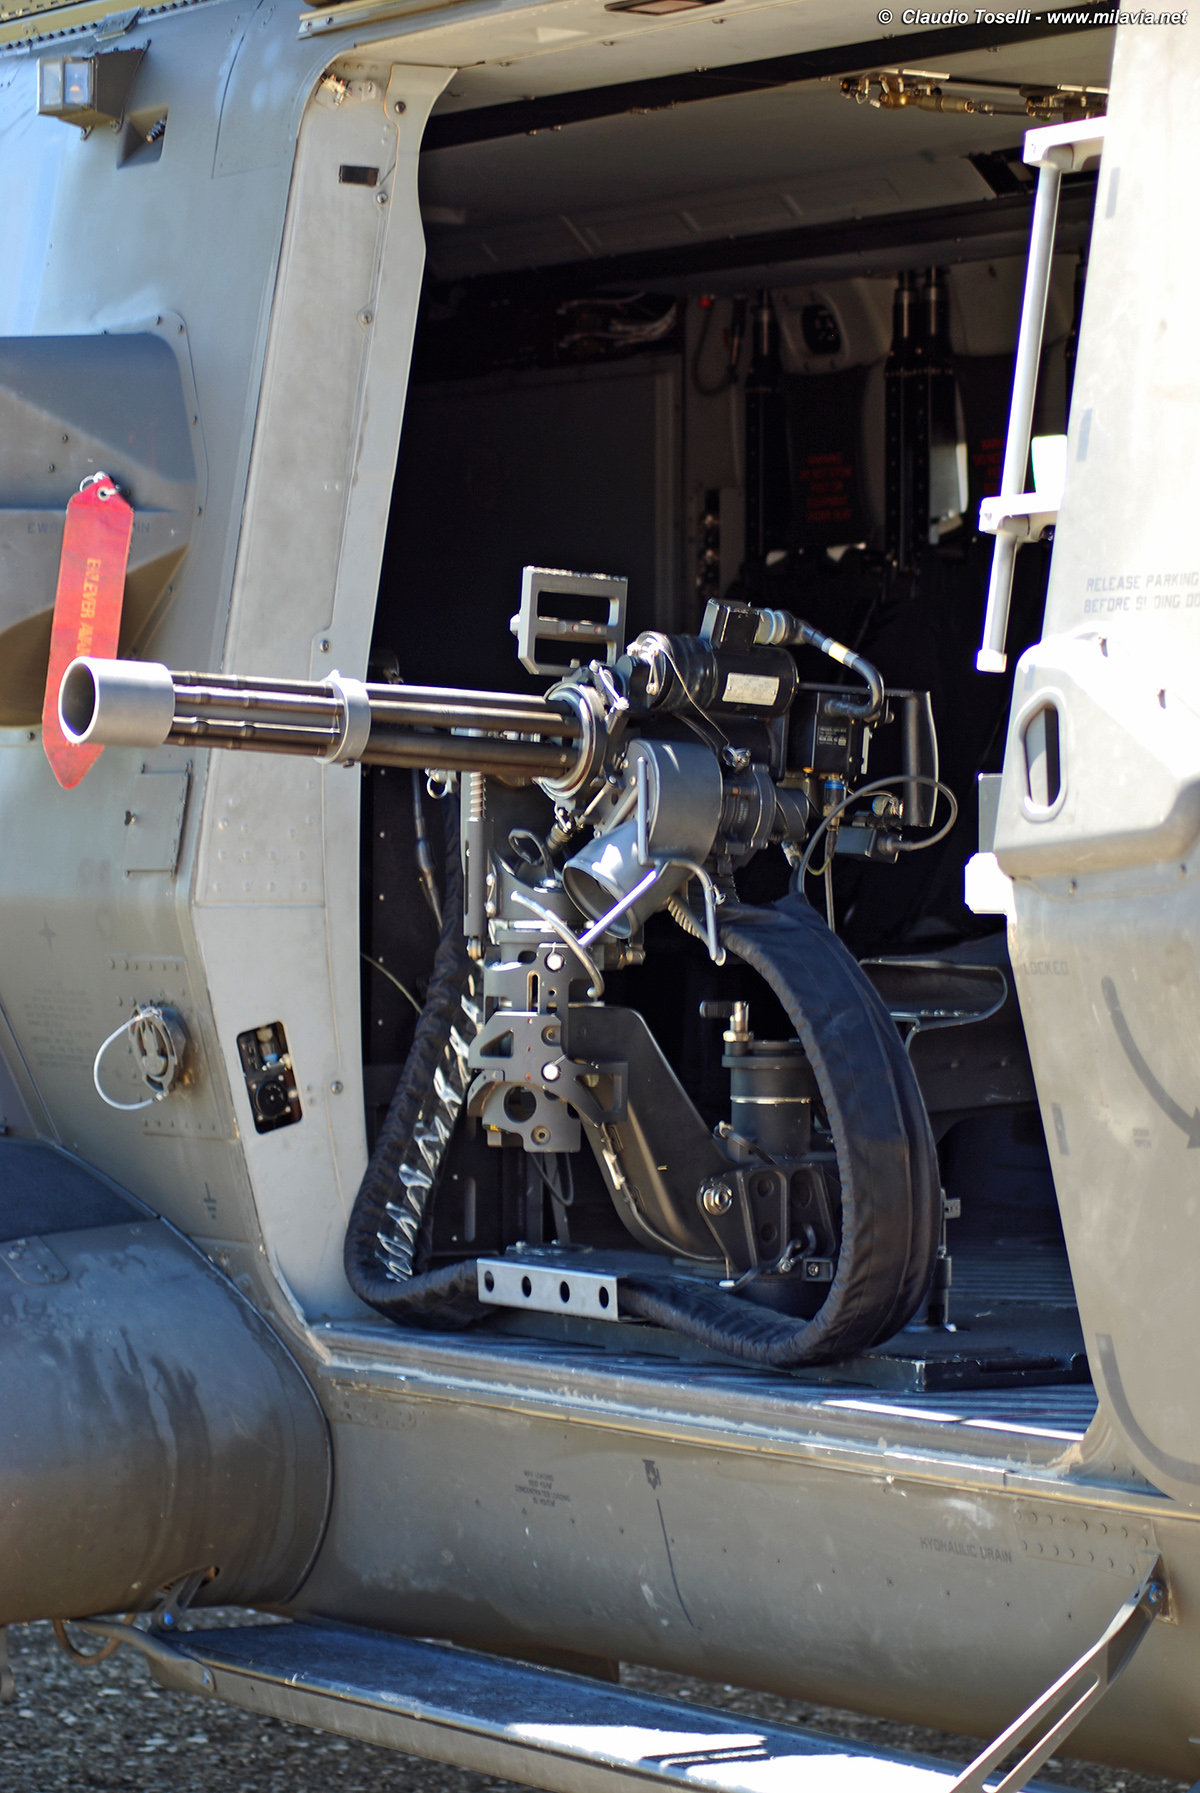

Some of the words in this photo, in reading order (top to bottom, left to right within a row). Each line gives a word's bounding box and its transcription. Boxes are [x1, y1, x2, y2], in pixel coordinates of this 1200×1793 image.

[1086, 575, 1141, 592] RELEASE
[1146, 572, 1199, 588] PARKING
[1083, 596, 1131, 613] BEFORE
[1136, 594, 1180, 611] SLDING
[1023, 961, 1069, 975] LOCKED
